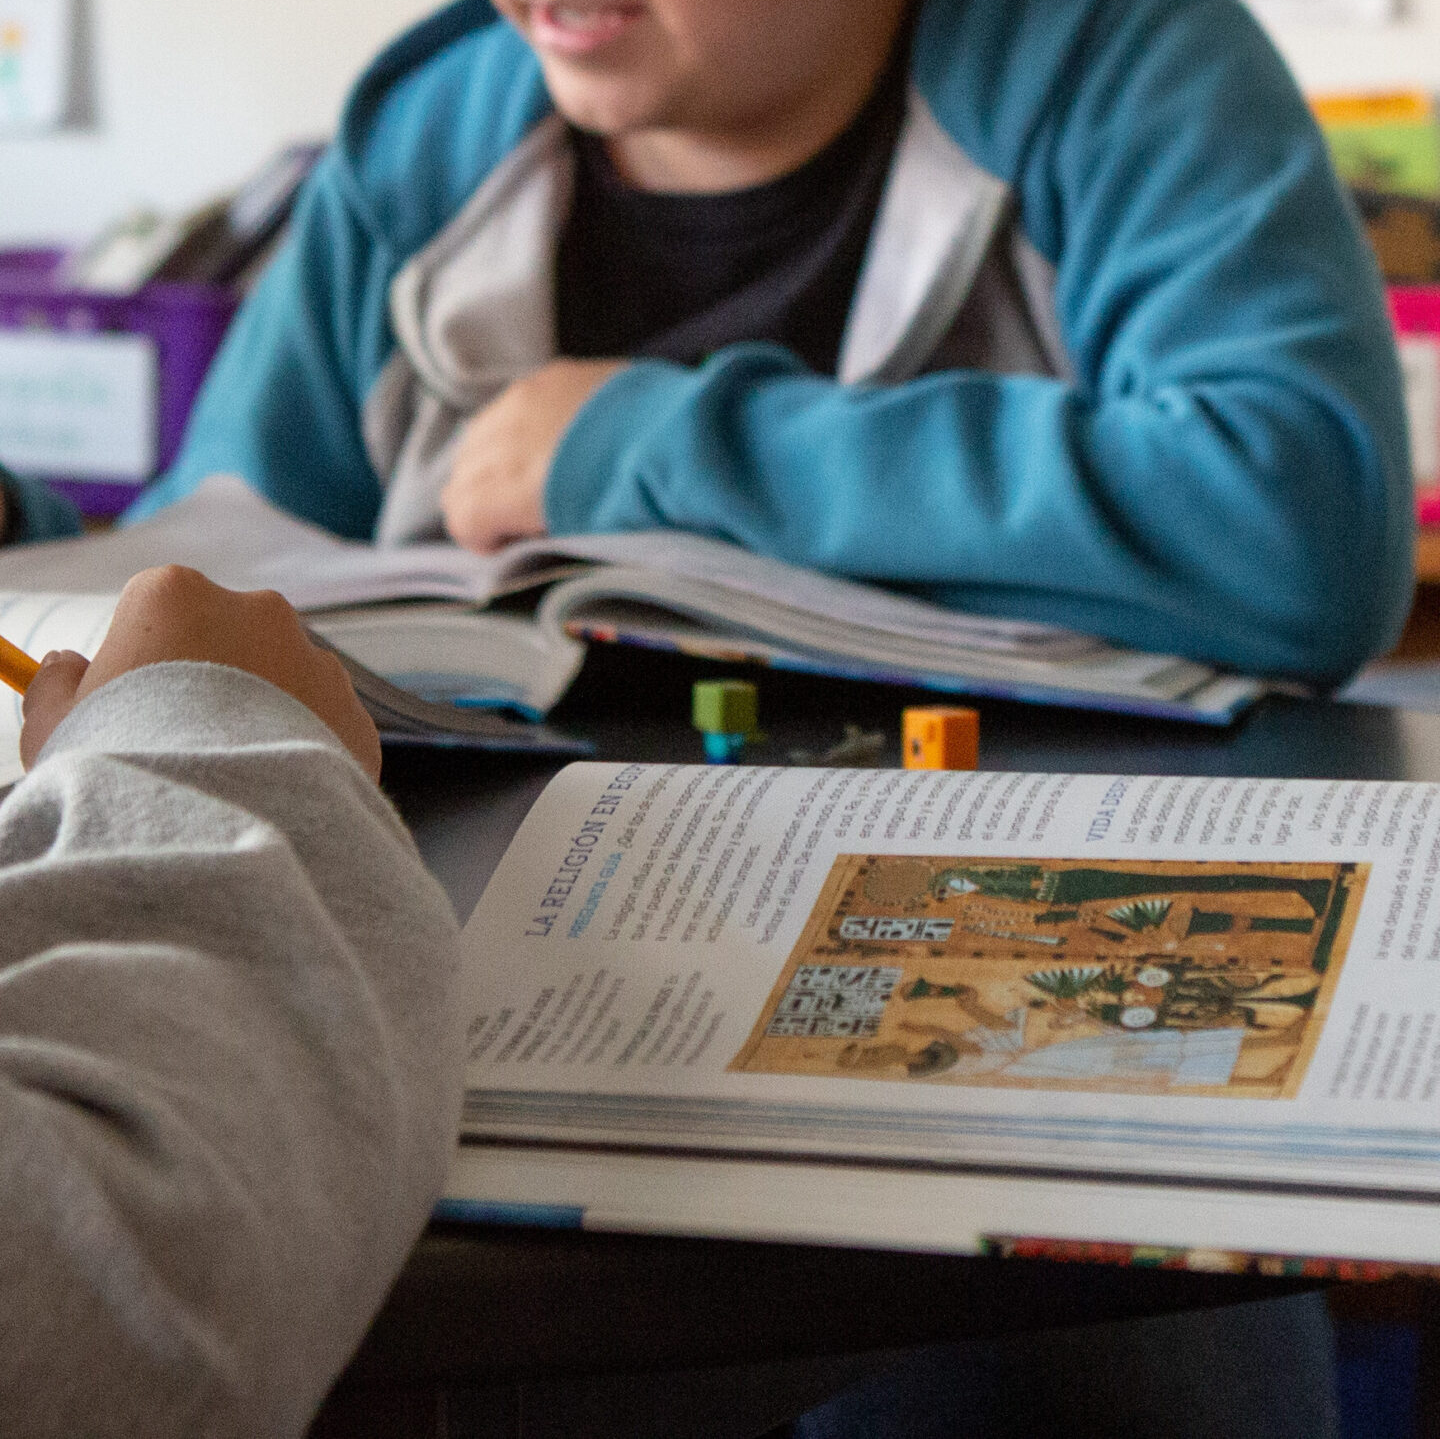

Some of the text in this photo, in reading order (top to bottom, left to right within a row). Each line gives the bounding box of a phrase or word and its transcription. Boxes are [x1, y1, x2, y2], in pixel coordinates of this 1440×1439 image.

[590, 794, 623, 815] EN
[668, 808, 684, 819] los
[652, 822, 675, 846] todos
[1085, 808, 1116, 842] VIDA
[1124, 826, 1139, 842] Los
[1357, 830, 1371, 846] Los
[540, 819, 607, 908] RELIGIÓN
[646, 849, 661, 859] en
[702, 848, 735, 897] poderosos
[731, 821, 748, 838] que
[793, 850, 813, 864] De
[804, 830, 823, 848] este
[659, 897, 688, 933] muchos
[677, 864, 703, 894] dioses
[711, 809, 730, 821] Sin
[741, 910, 759, 927] Los
[752, 869, 780, 909] egipcios
[794, 804, 810, 817] del
[1395, 868, 1411, 881] de
[646, 878, 671, 910] pueblo
[663, 863, 678, 875] de
[1413, 886, 1433, 920] mundo
[612, 893, 639, 926] religión
[706, 890, 740, 943] actividades
[1384, 884, 1408, 926] después
[524, 912, 559, 936] LA
[603, 929, 621, 940] La
